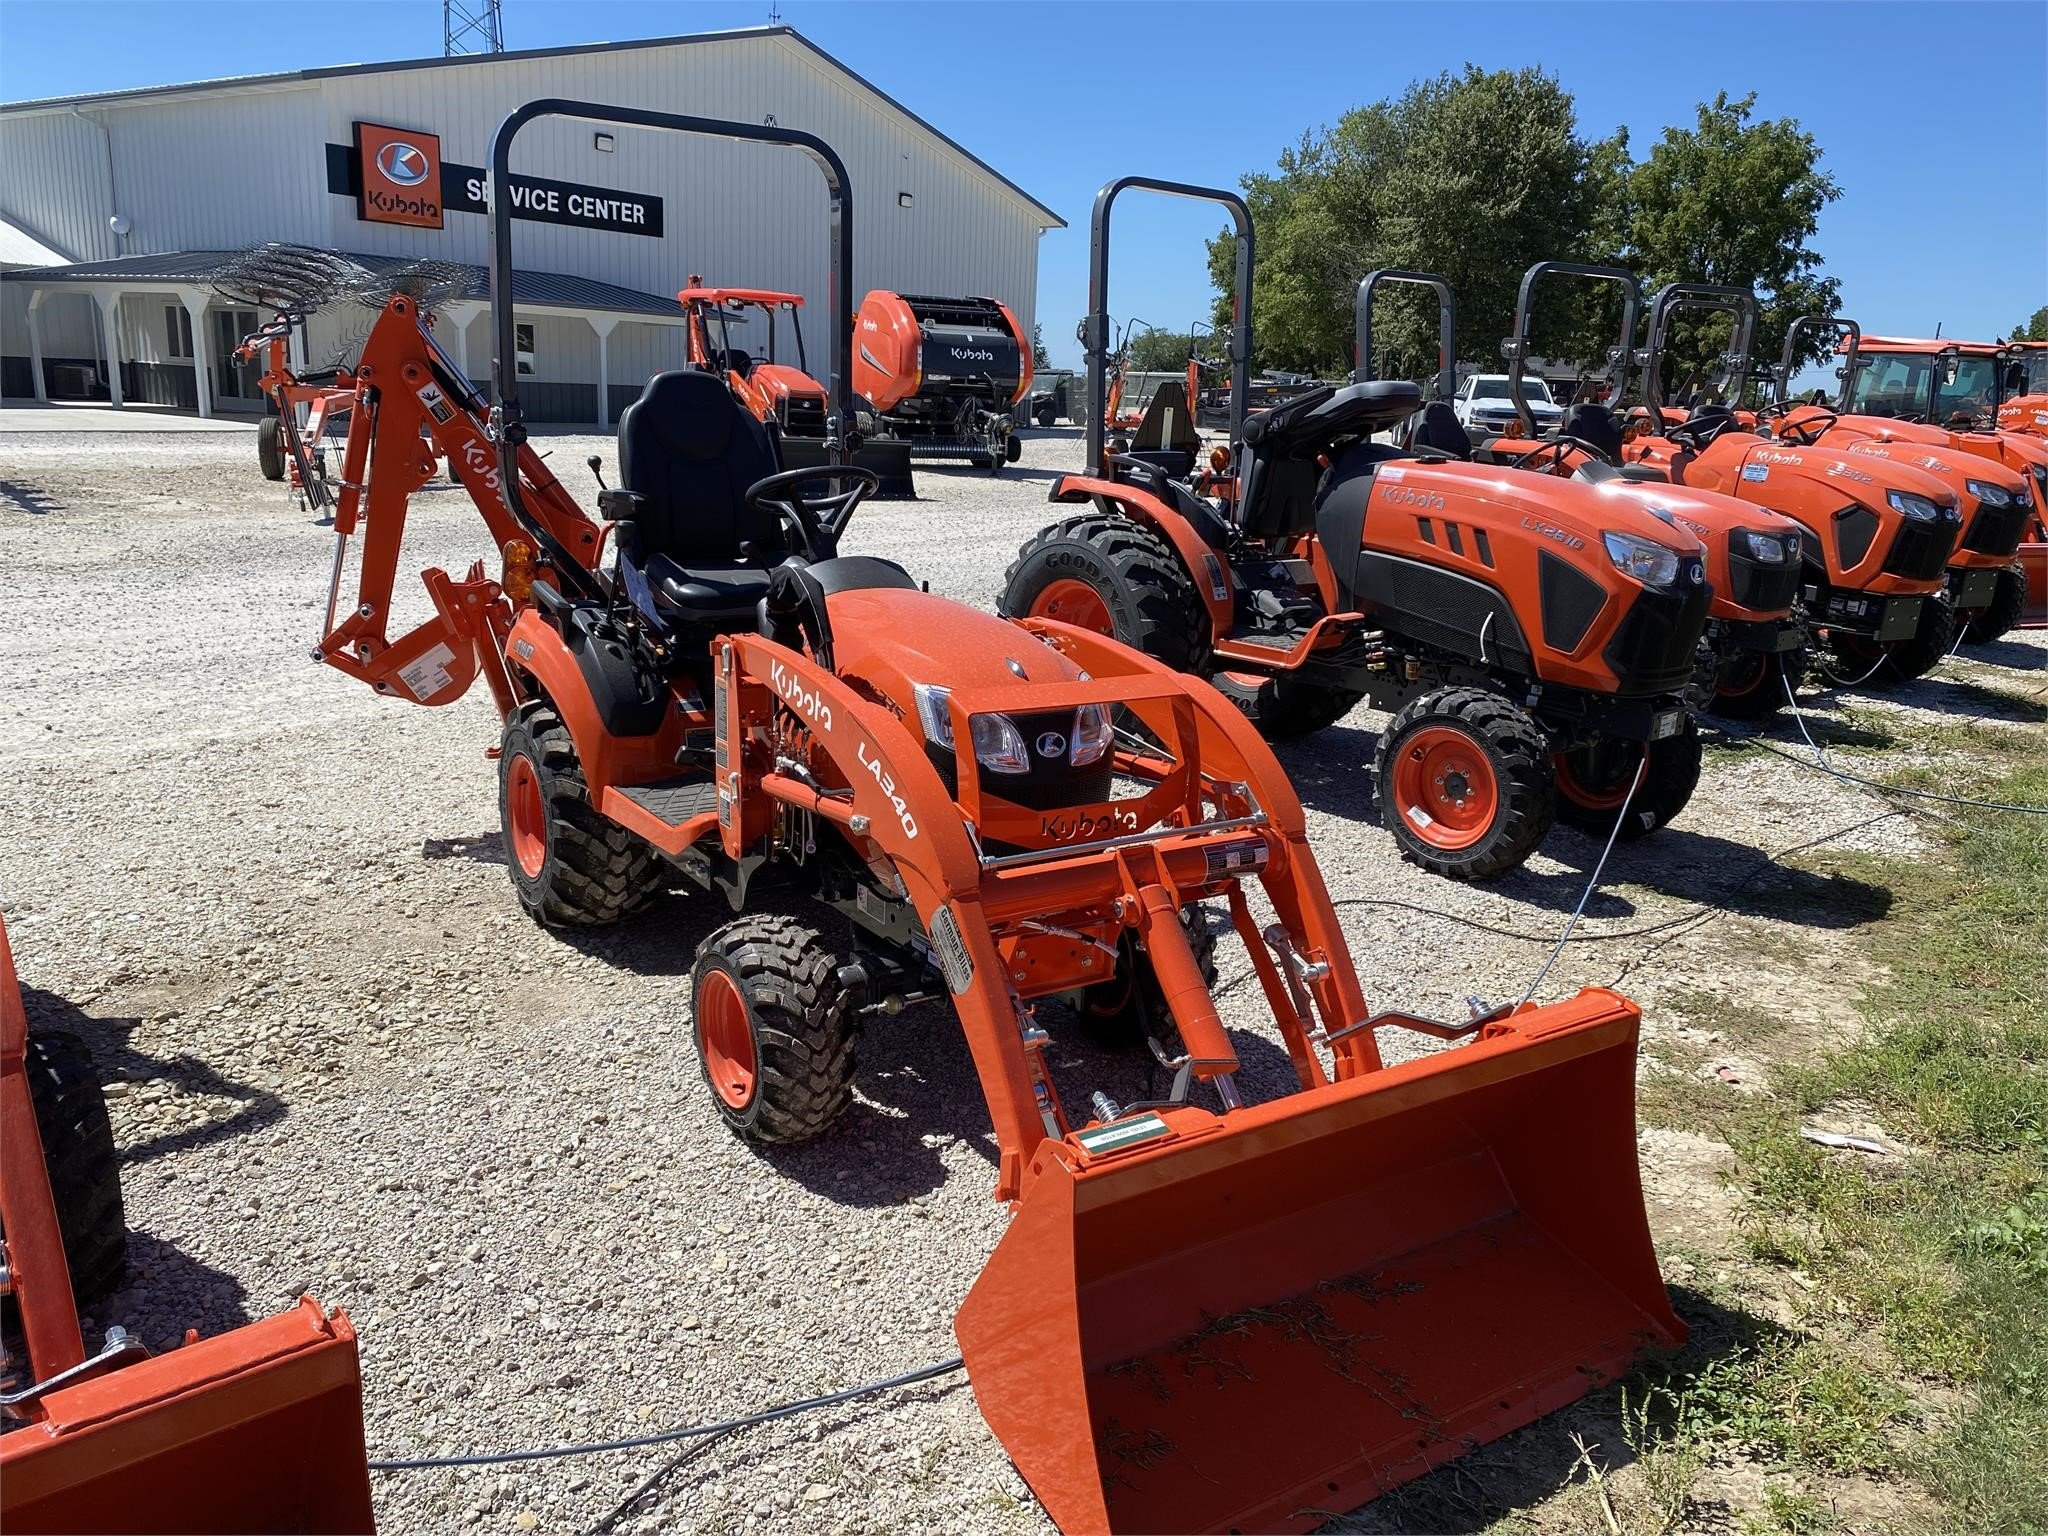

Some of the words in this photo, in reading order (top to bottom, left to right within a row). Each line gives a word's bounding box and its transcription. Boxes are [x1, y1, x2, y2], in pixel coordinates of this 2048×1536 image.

[367, 190, 439, 218] Kubota
[467, 178, 560, 213] SEVICE
[568, 195, 645, 224] CENTER
[951, 347, 993, 361] Kubota
[1756, 450, 1803, 466] Kubota
[1850, 445, 1889, 459] Kubota
[1381, 485, 1446, 511] Kubota
[1520, 516, 1585, 552] LX2610
[770, 658, 833, 733] Kubota
[857, 741, 918, 840] LA340
[1041, 806, 1138, 841] Kubota
[940, 908, 971, 981] German-Bliss
